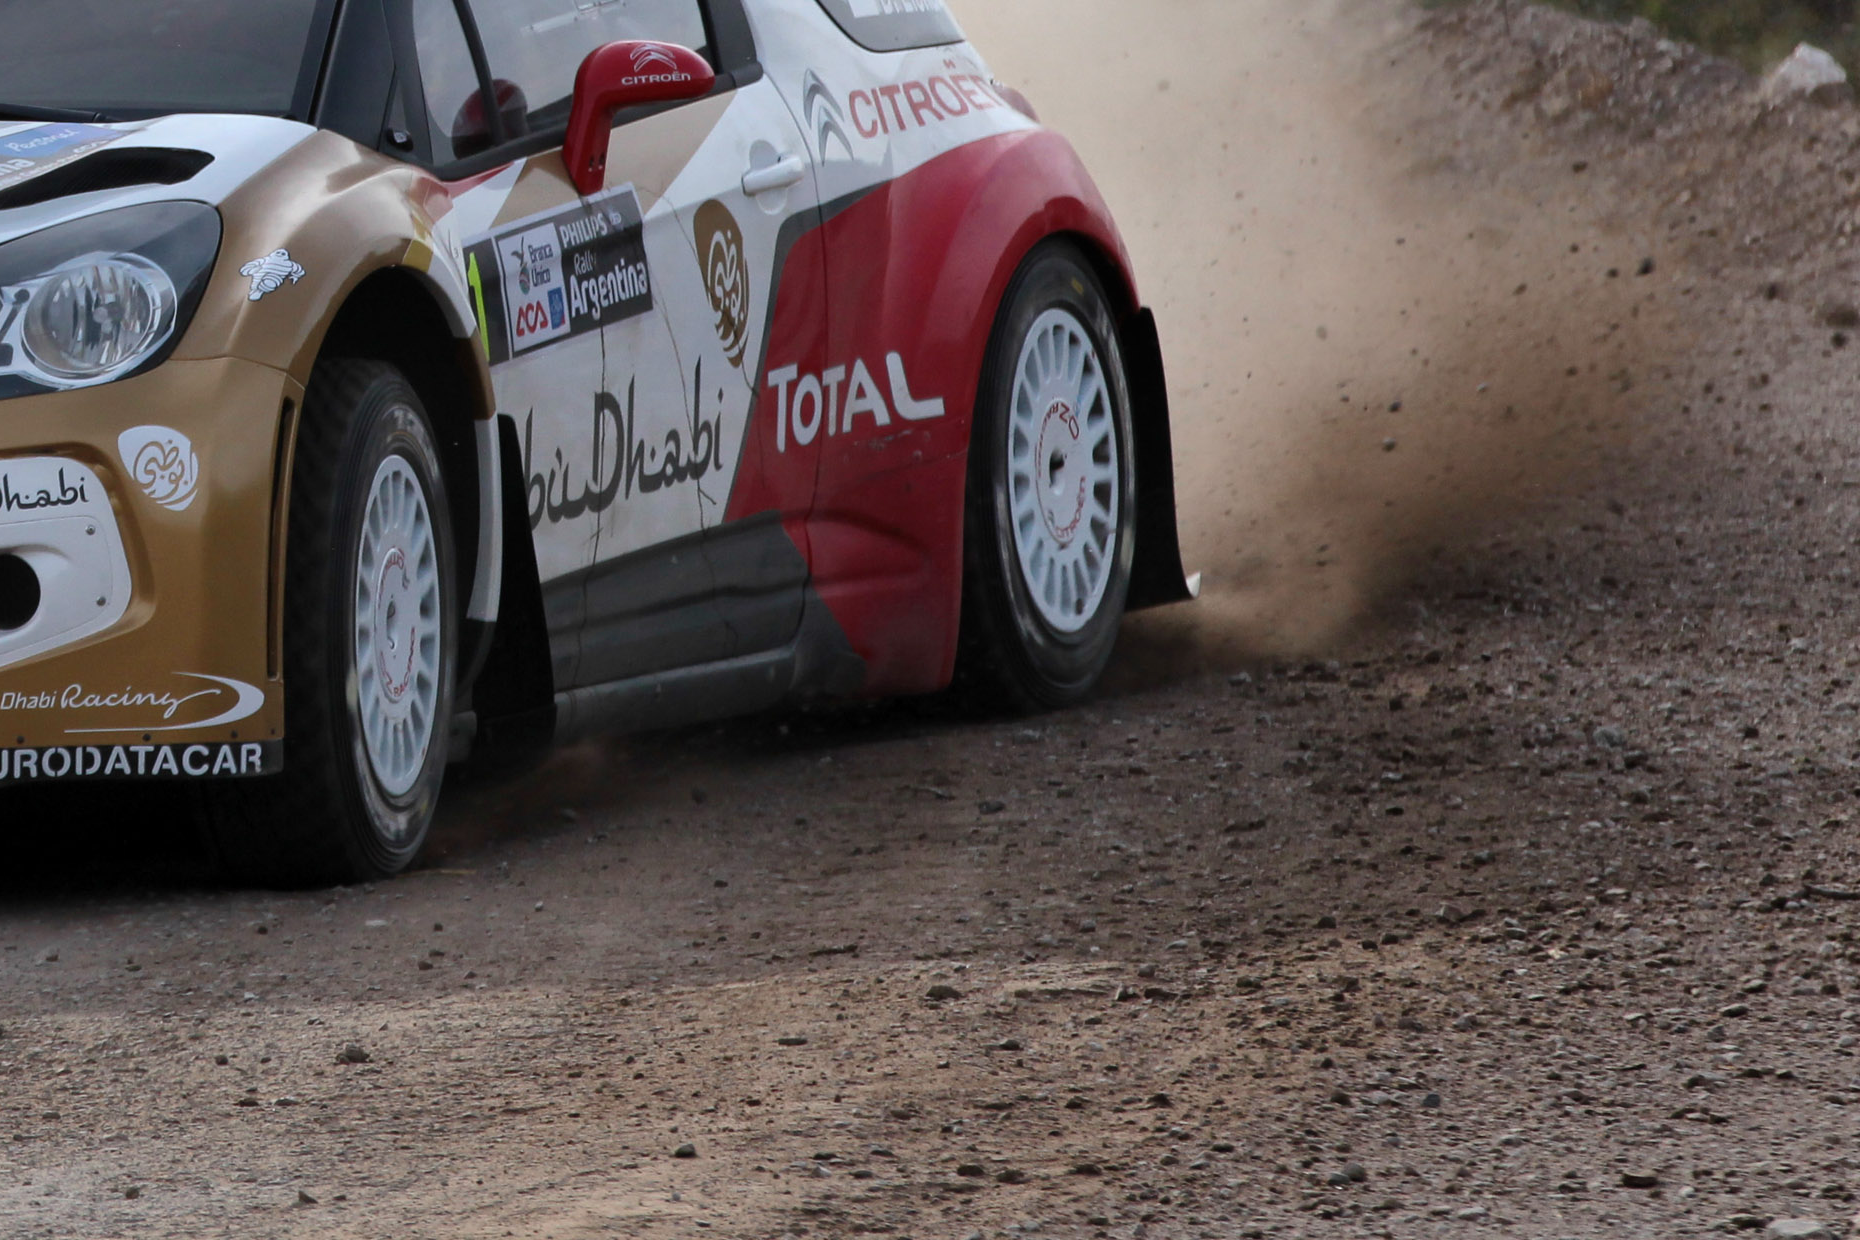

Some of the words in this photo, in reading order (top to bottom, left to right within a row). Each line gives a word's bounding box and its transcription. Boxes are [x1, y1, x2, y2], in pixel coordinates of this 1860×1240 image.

[559, 212, 608, 249] PHILIPS
[570, 257, 648, 321] Argentina
[516, 300, 548, 338] ACA
[767, 351, 945, 453] TOTAL
[0, 689, 57, 711] Dhabi
[60, 681, 222, 719] Racing
